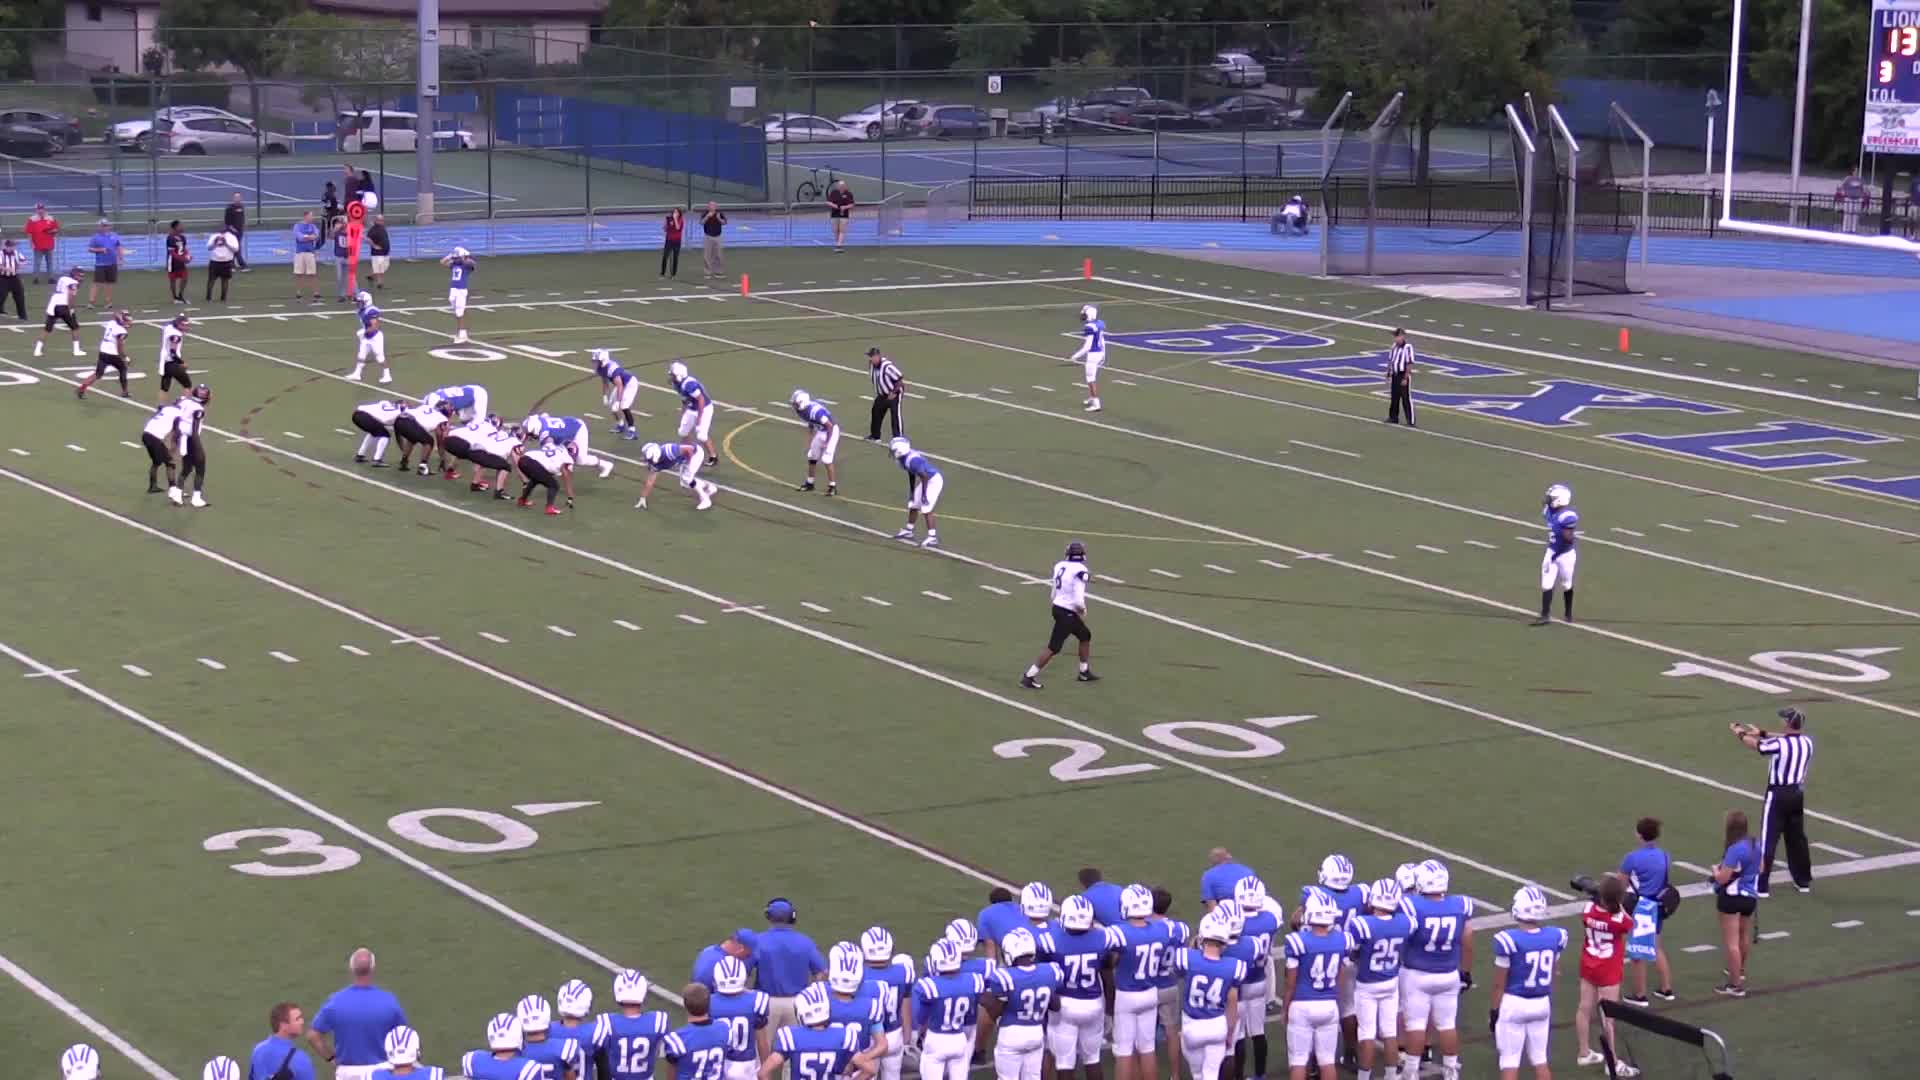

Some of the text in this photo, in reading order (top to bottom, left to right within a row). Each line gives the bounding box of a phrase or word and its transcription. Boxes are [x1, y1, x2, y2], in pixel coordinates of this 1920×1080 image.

[1890, 27, 1917, 55] 13
[1879, 60, 1892, 82] 3
[1424, 916, 1456, 951] 77
[1584, 928, 1614, 958] 15
[1064, 953, 1098, 989] 75
[1135, 942, 1163, 980] 76
[1310, 953, 1340, 989] 44
[1369, 938, 1403, 971] 25
[1524, 951, 1553, 987] 79
[1017, 987, 1050, 1020] 33
[1189, 975, 1223, 1009] 64
[942, 997, 970, 1032] 18
[617, 1037, 650, 1072] 12
[692, 1047, 724, 1080] 73
[800, 1052, 836, 1080] 57
